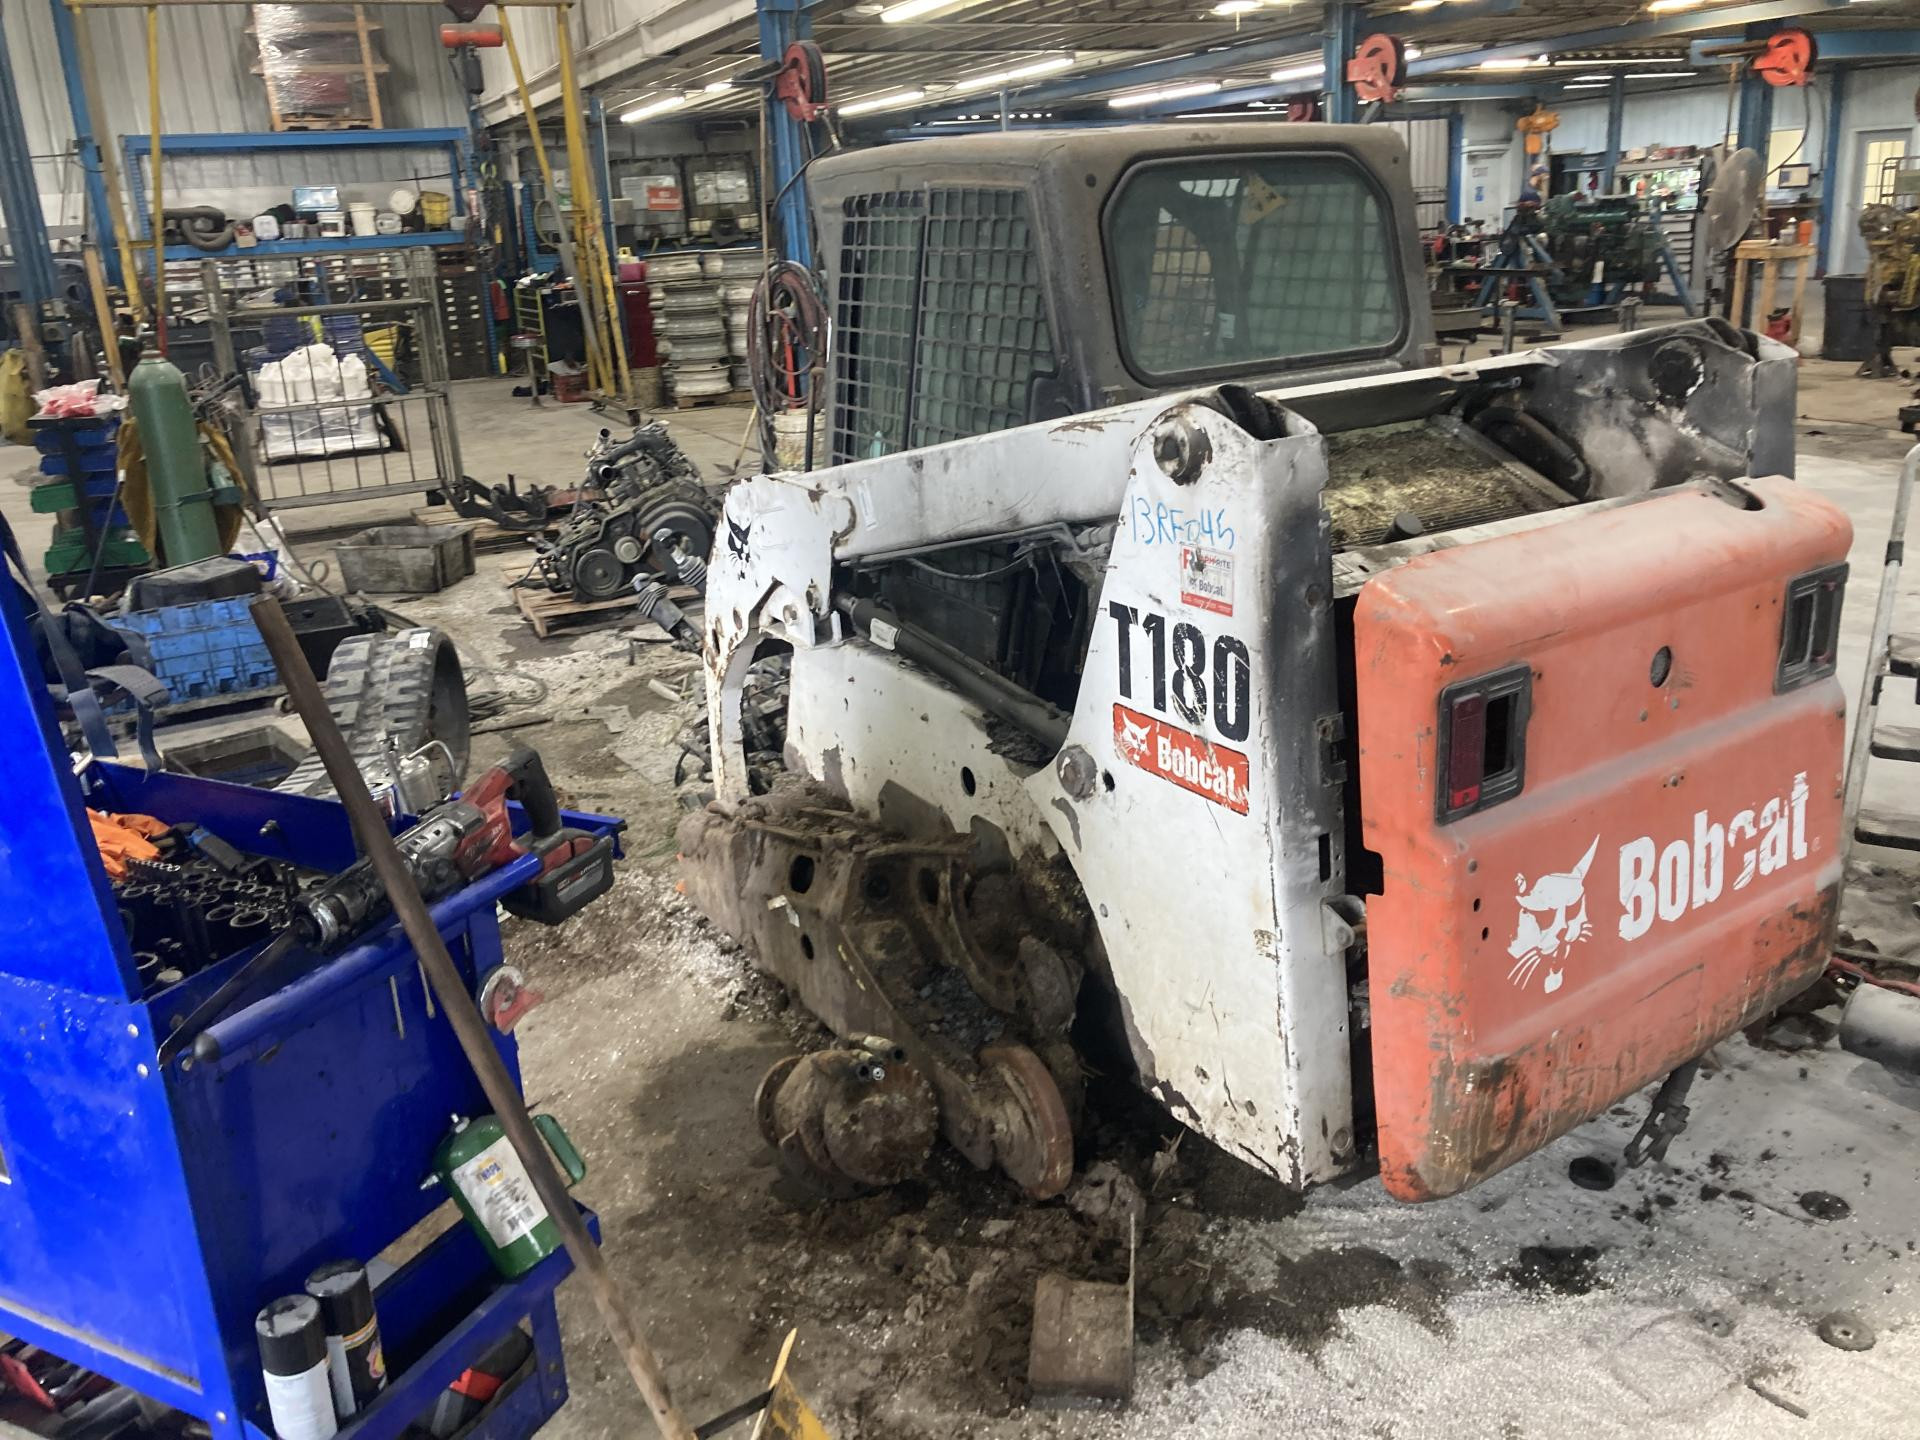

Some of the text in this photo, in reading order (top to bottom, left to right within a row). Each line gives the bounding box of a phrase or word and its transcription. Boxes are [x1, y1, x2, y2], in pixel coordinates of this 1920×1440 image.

[1109, 600, 1250, 742] T180
[1157, 735, 1238, 802] Bobcat
[1618, 771, 1809, 941] Bobcat
